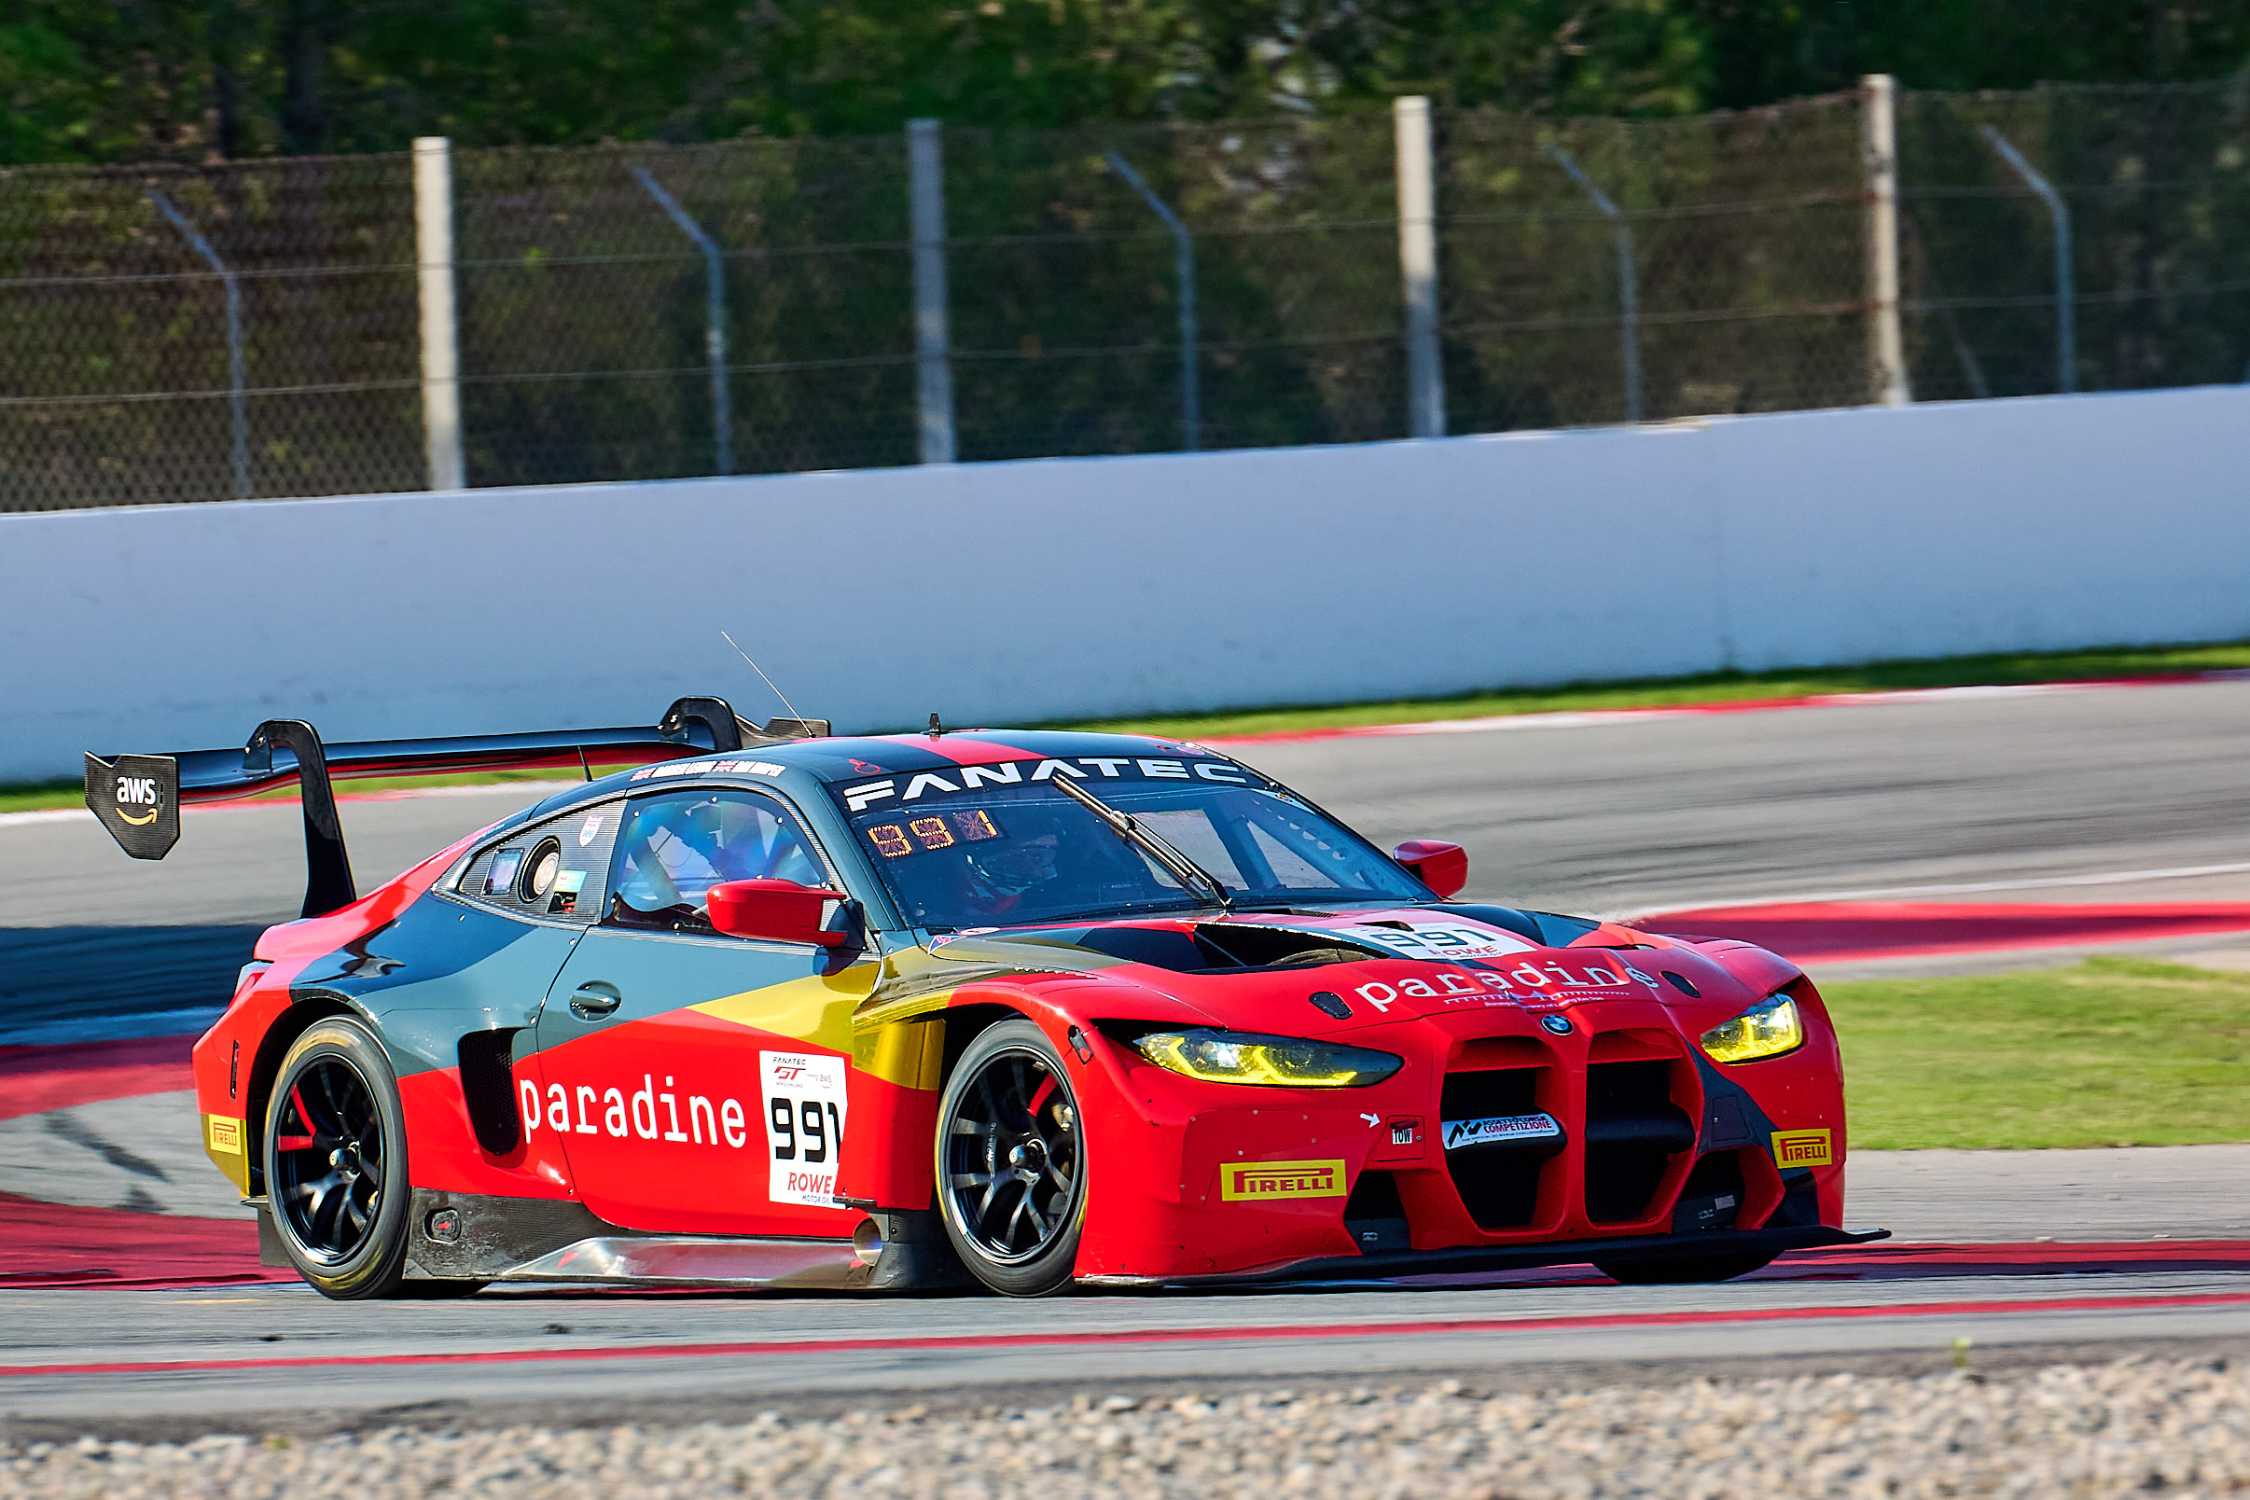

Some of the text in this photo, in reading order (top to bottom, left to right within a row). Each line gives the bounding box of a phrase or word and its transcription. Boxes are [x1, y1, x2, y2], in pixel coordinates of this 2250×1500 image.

[117, 777, 156, 804] aws
[844, 758, 1247, 812] FANATEC
[867, 809, 999, 858] 991
[1370, 929, 1496, 947] 991
[1355, 961, 1660, 1013] paradine
[519, 1073, 747, 1148] paradine
[771, 1097, 842, 1164] 991
[1393, 1128, 1412, 1143] TOW
[1484, 1120, 1553, 1133] COMPETIZIONE
[1779, 1136, 1827, 1162] PIRELLI
[787, 1171, 833, 1194] ROWE
[1233, 1167, 1334, 1193] PIRELLI
